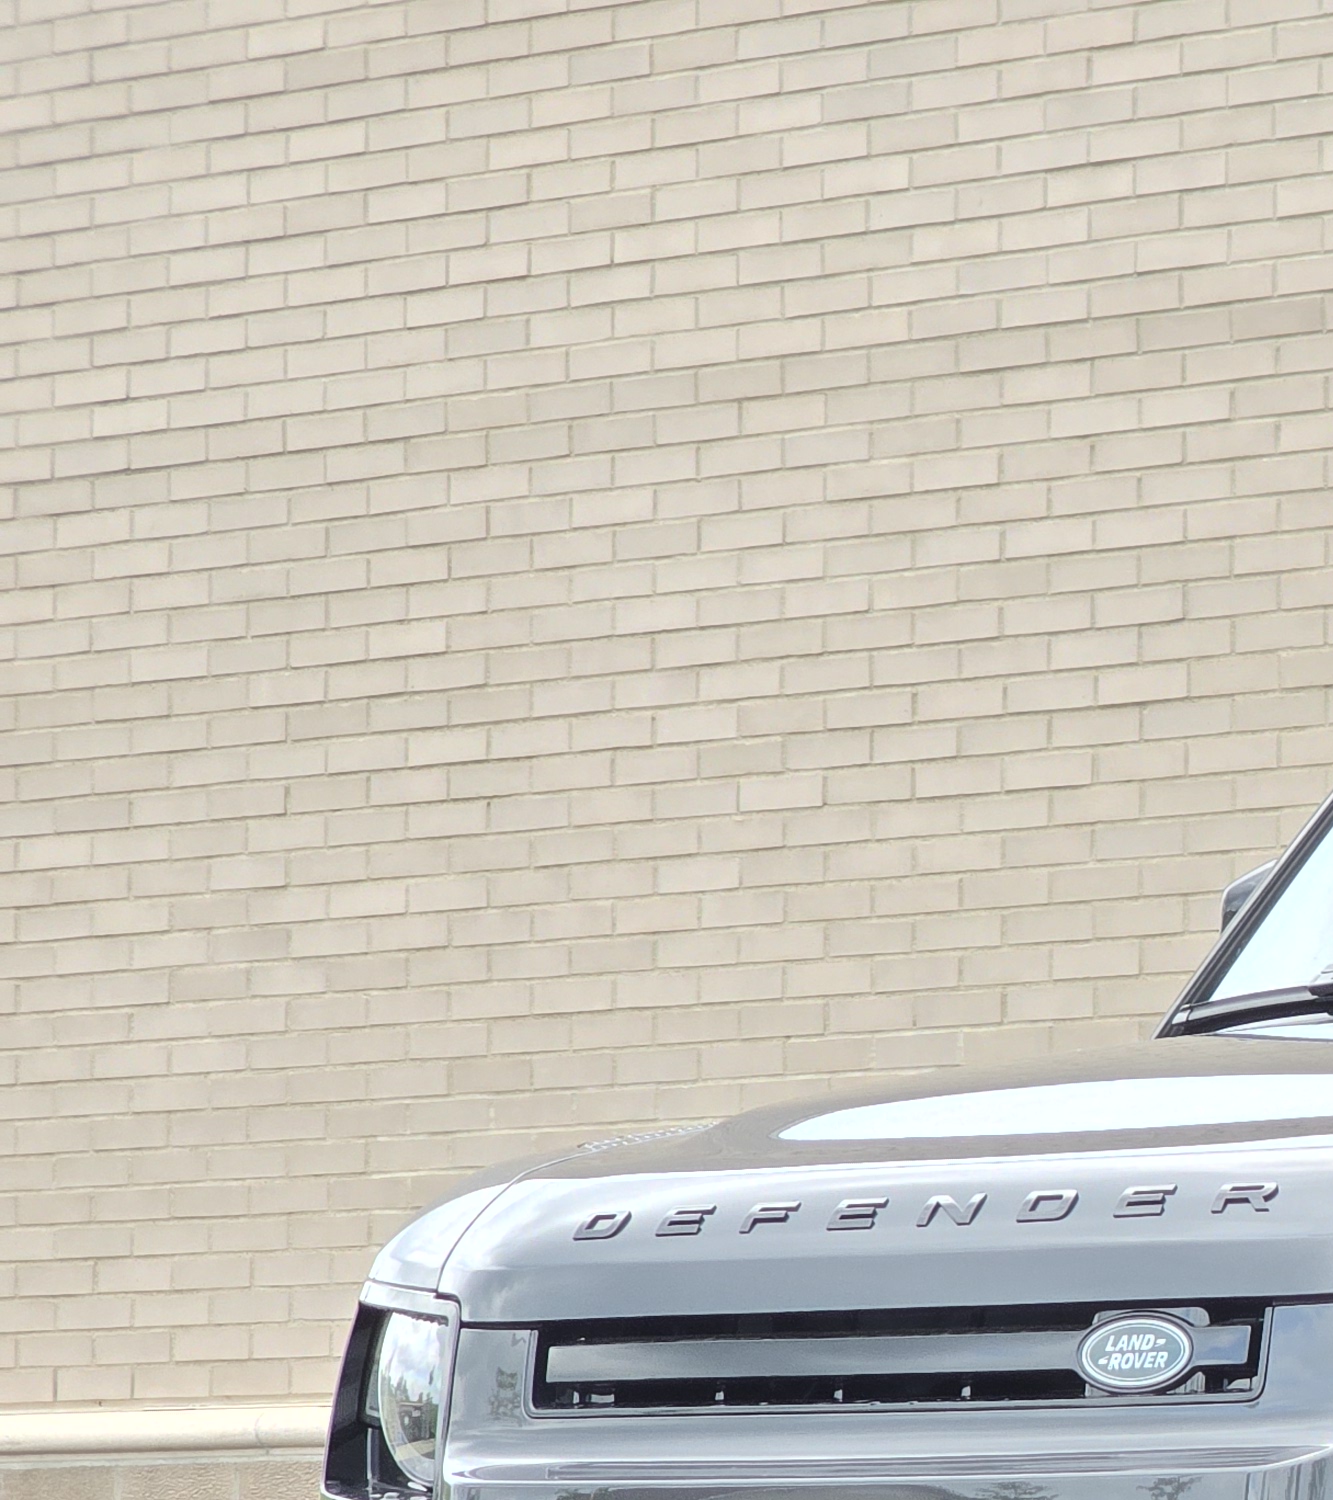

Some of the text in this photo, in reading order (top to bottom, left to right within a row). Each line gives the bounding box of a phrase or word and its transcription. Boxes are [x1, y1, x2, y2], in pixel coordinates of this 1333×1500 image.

[572, 1181, 1280, 1242] DEFENDER
[1105, 1334, 1155, 1351] LAND
[1107, 1352, 1168, 1370] ROVER
